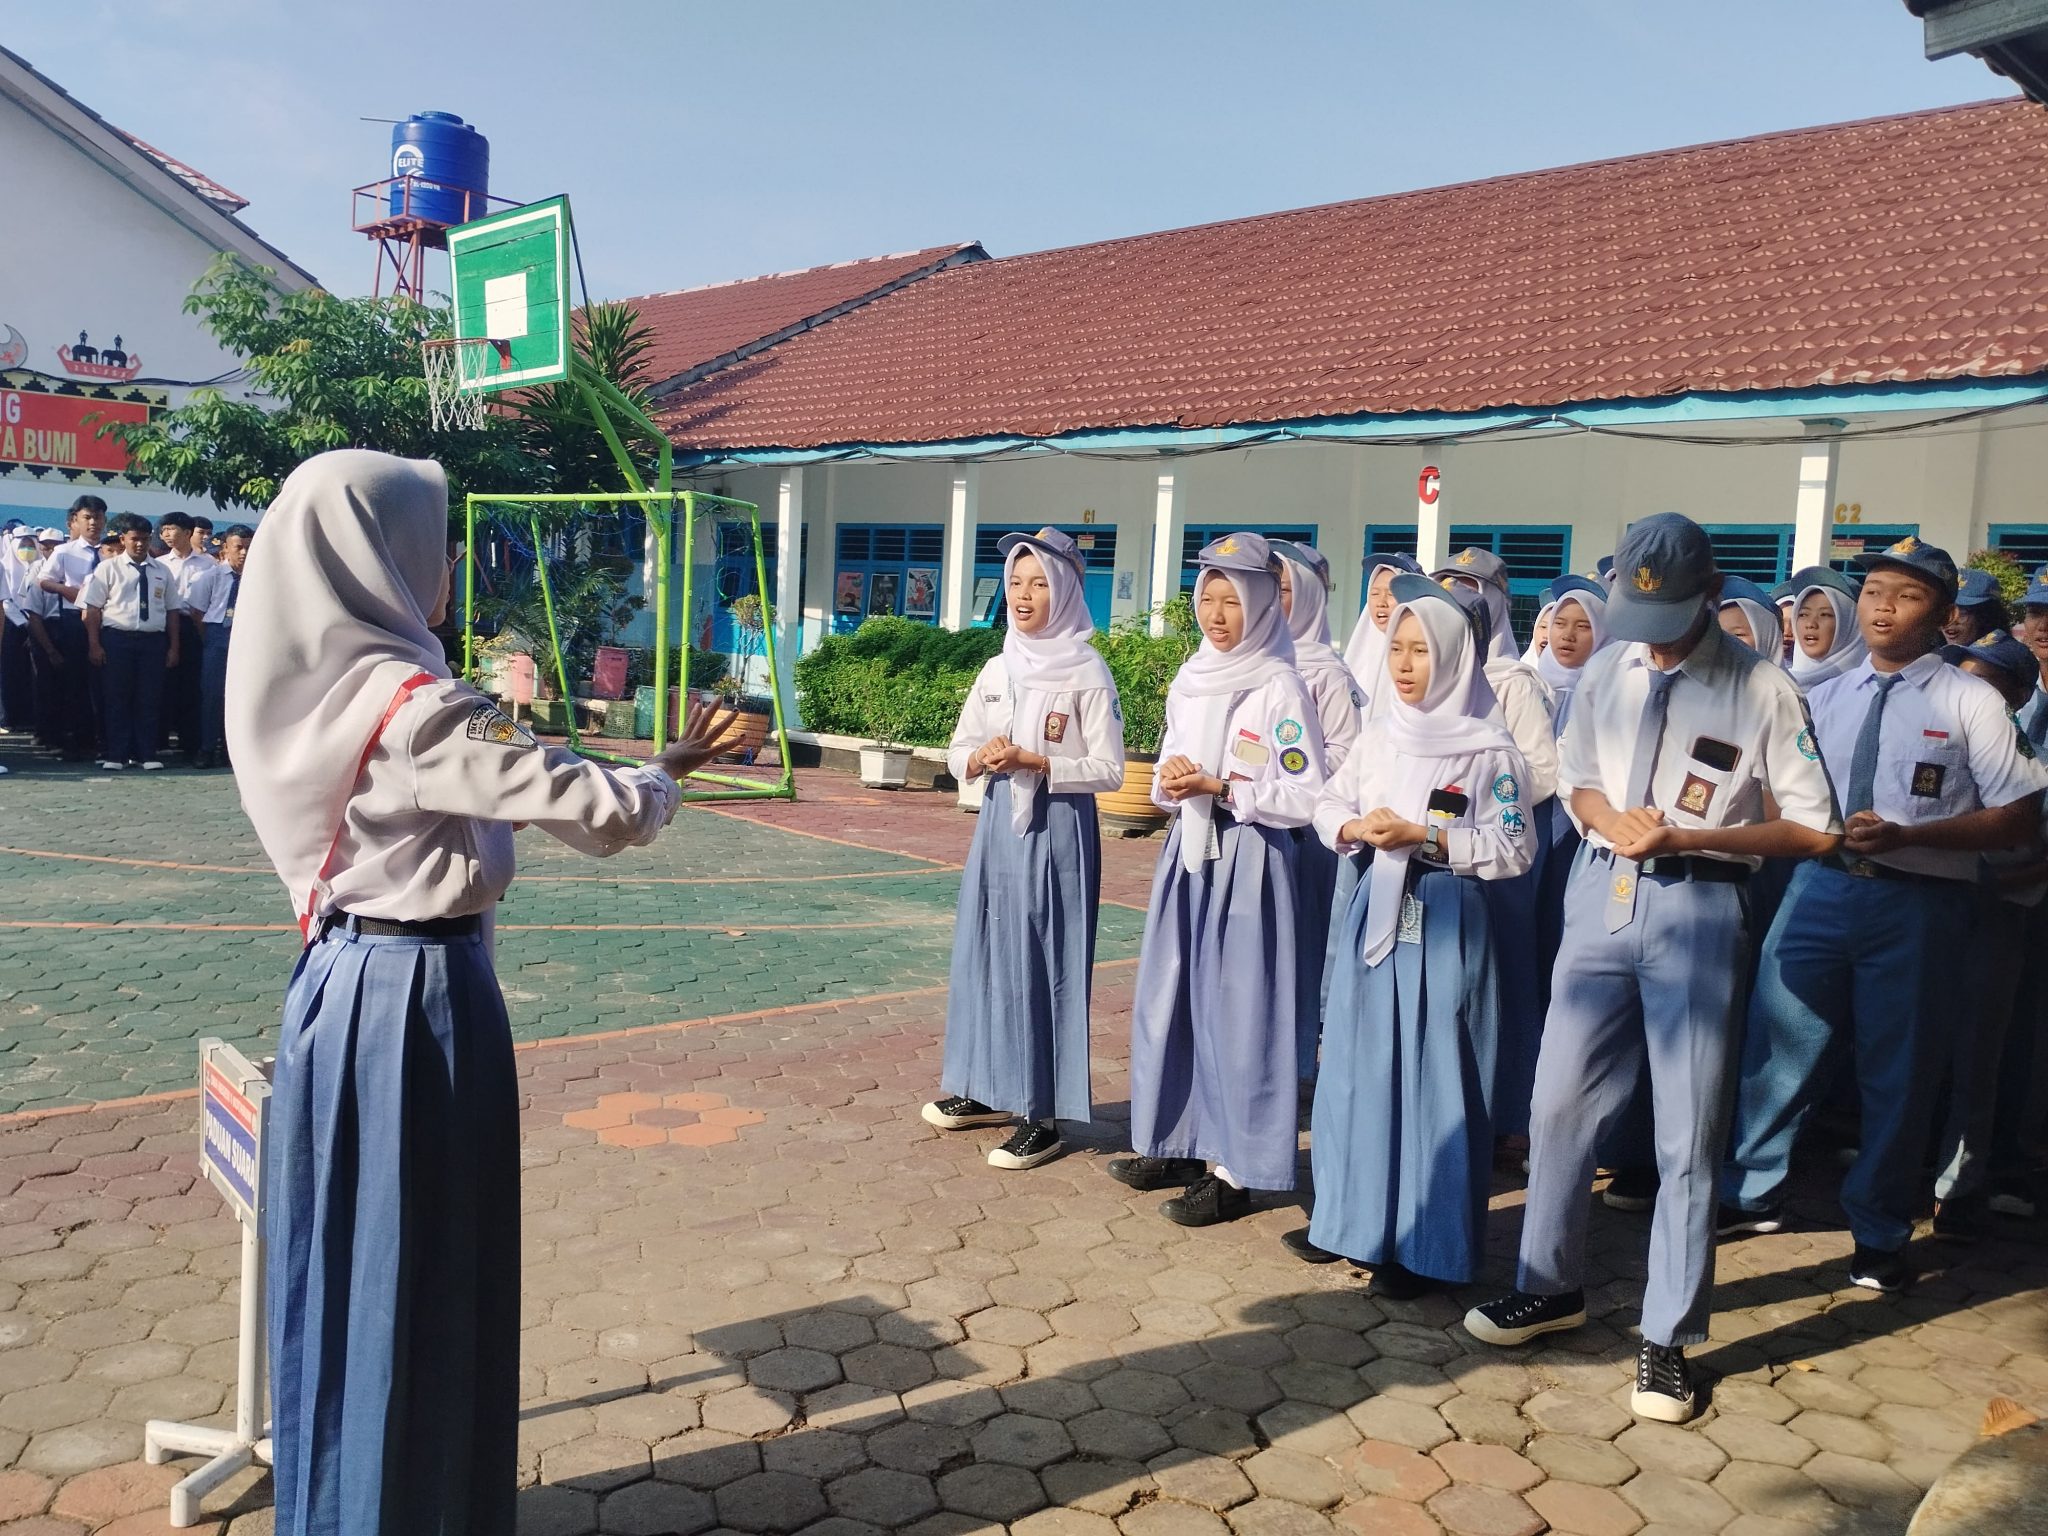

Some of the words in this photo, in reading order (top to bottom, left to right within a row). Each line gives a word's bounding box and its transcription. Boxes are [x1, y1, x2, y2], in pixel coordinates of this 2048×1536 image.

[398, 157, 425, 168] ELITE
[0, 392, 21, 424] G
[0, 426, 17, 458] A
[23, 428, 77, 465] BUMI
[1418, 466, 1440, 505] C
[205, 1109, 232, 1163] PADUAN
[231, 1138, 255, 1192] SUARA
